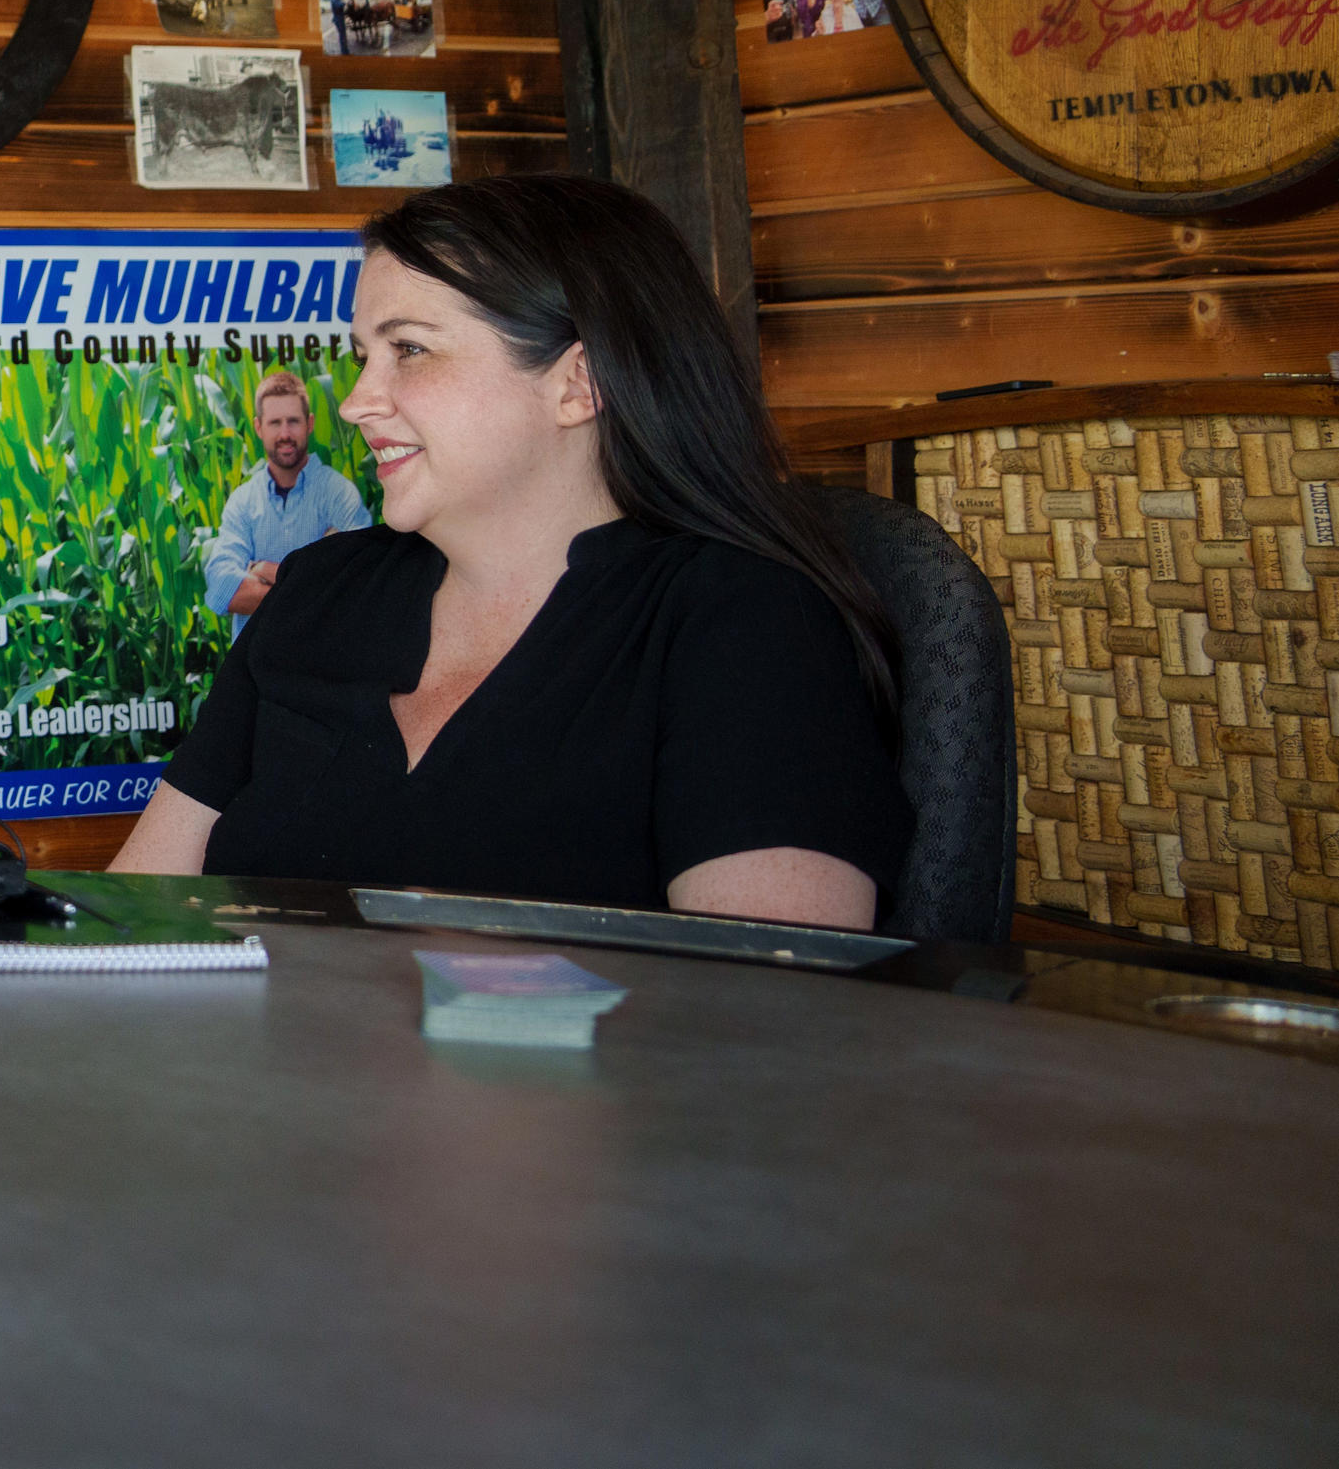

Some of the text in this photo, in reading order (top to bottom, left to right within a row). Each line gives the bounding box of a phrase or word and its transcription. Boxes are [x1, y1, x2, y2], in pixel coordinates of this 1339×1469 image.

[1047, 69, 1337, 123] TEMPLETON, IOWA
[54, 329, 203, 368] County
[17, 696, 175, 738] Leadership
[62, 778, 111, 806] FOR
